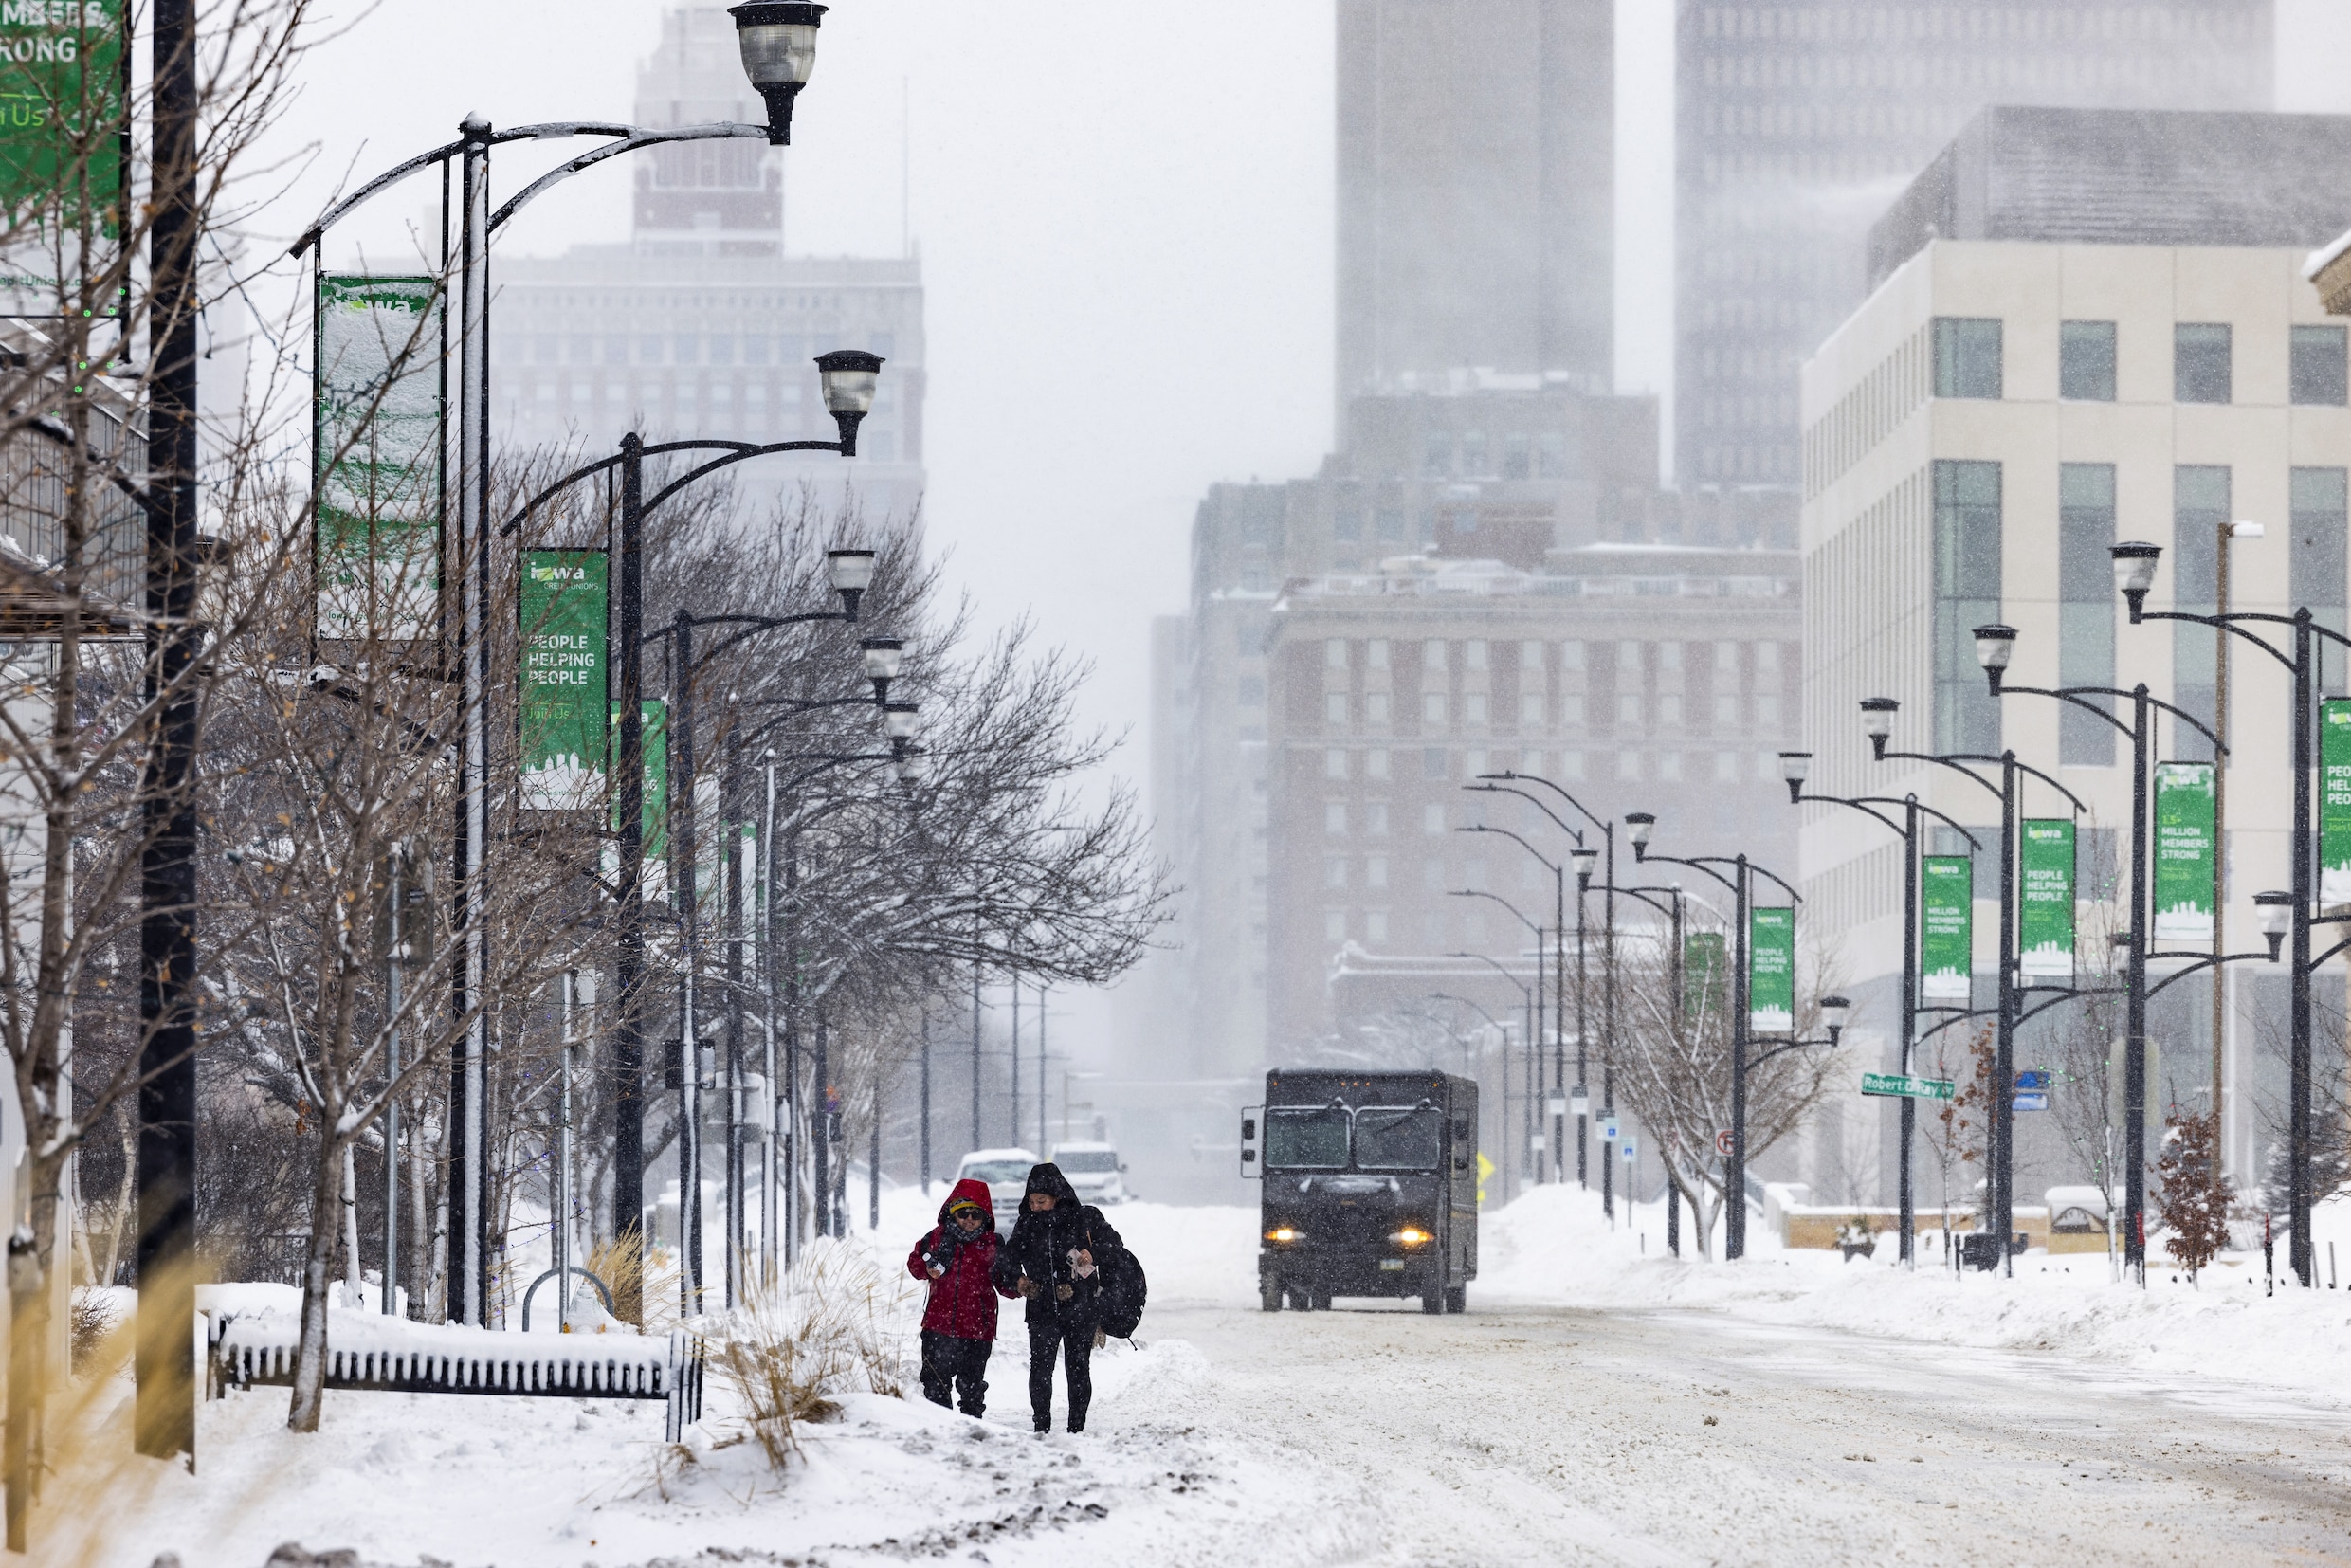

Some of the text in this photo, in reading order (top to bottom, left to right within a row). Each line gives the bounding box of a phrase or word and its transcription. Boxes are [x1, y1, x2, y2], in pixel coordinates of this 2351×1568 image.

[11, 103, 45, 127] Us
[529, 635, 588, 649] PEOPLE
[528, 652, 595, 667] HELPING
[528, 670, 588, 684] PEOPLE
[2161, 827, 2201, 837] MILLION
[2161, 838, 2209, 848] MEMBERS
[2160, 849, 2201, 860] STRONG
[2027, 870, 2064, 881] PEOPLE
[2027, 881, 2069, 891] HELPING
[2027, 891, 2064, 902] PEOPLE
[1927, 906, 1960, 916] MILLION
[1927, 916, 1967, 925] MEMBERS
[1927, 924, 1960, 934] STRONG
[1755, 948, 1784, 957] PEOPLE
[1755, 957, 1788, 965] HELPING
[1755, 965, 1784, 974] PEOPLE
[1864, 1076, 1902, 1091] Robert
[1918, 1082, 1939, 1097] Ray
